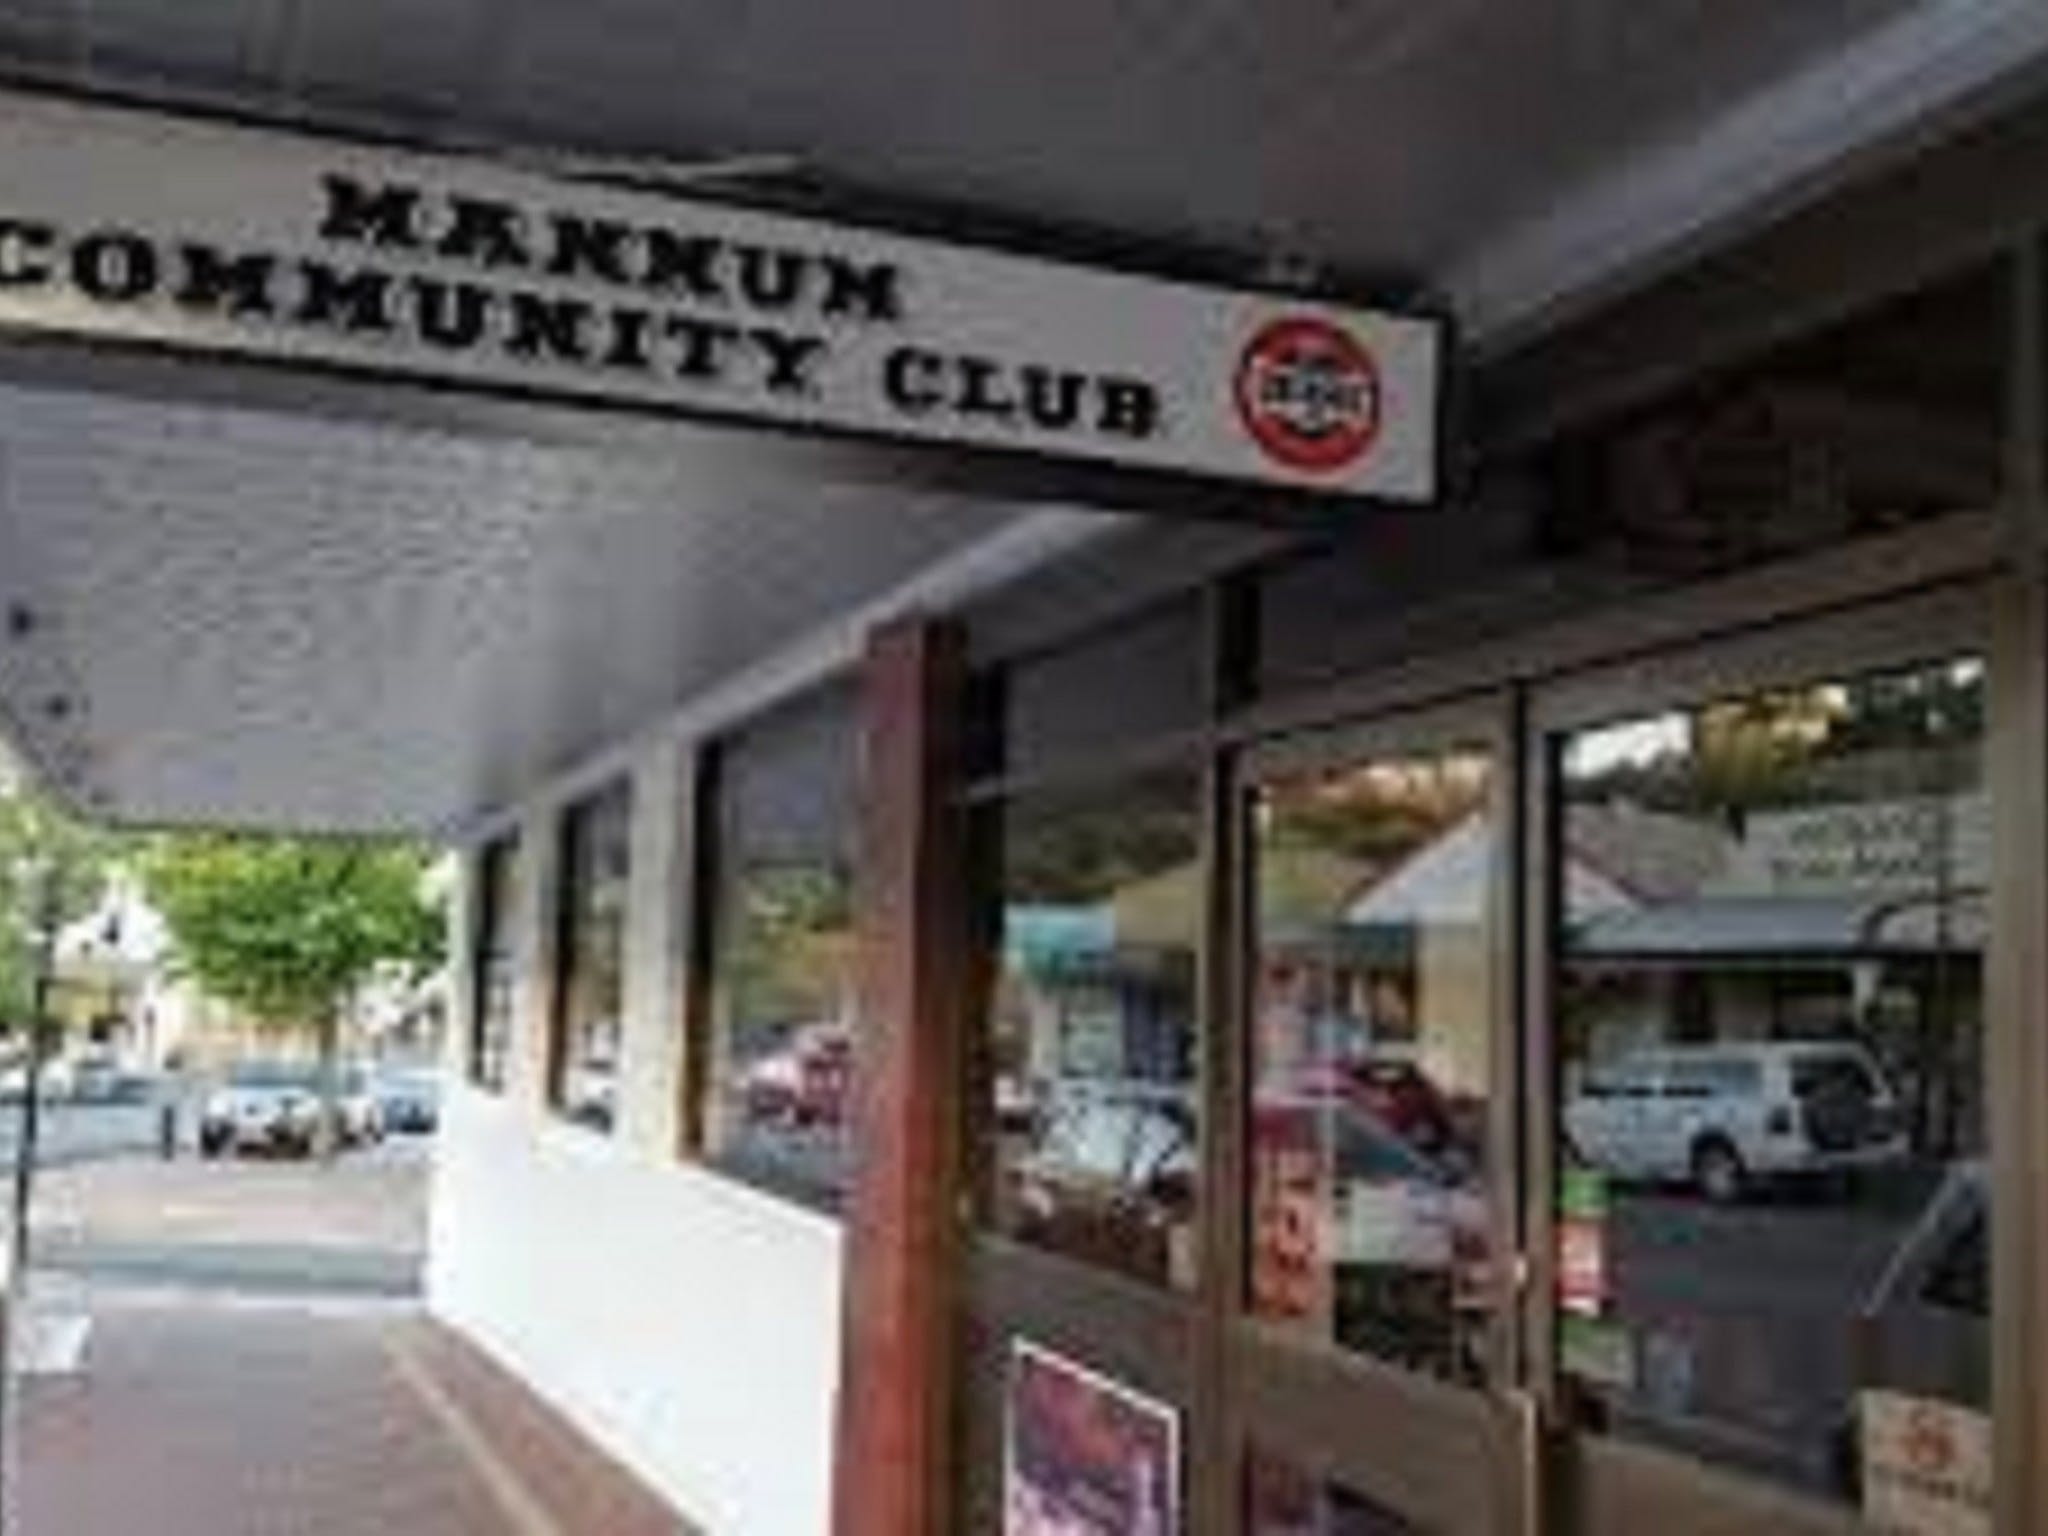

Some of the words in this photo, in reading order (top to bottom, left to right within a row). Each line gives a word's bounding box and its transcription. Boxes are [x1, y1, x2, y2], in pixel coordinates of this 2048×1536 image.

[0, 218, 824, 392] COMMUNITY
[884, 346, 1162, 438] CLUB
[320, 174, 901, 321] MANNUM
